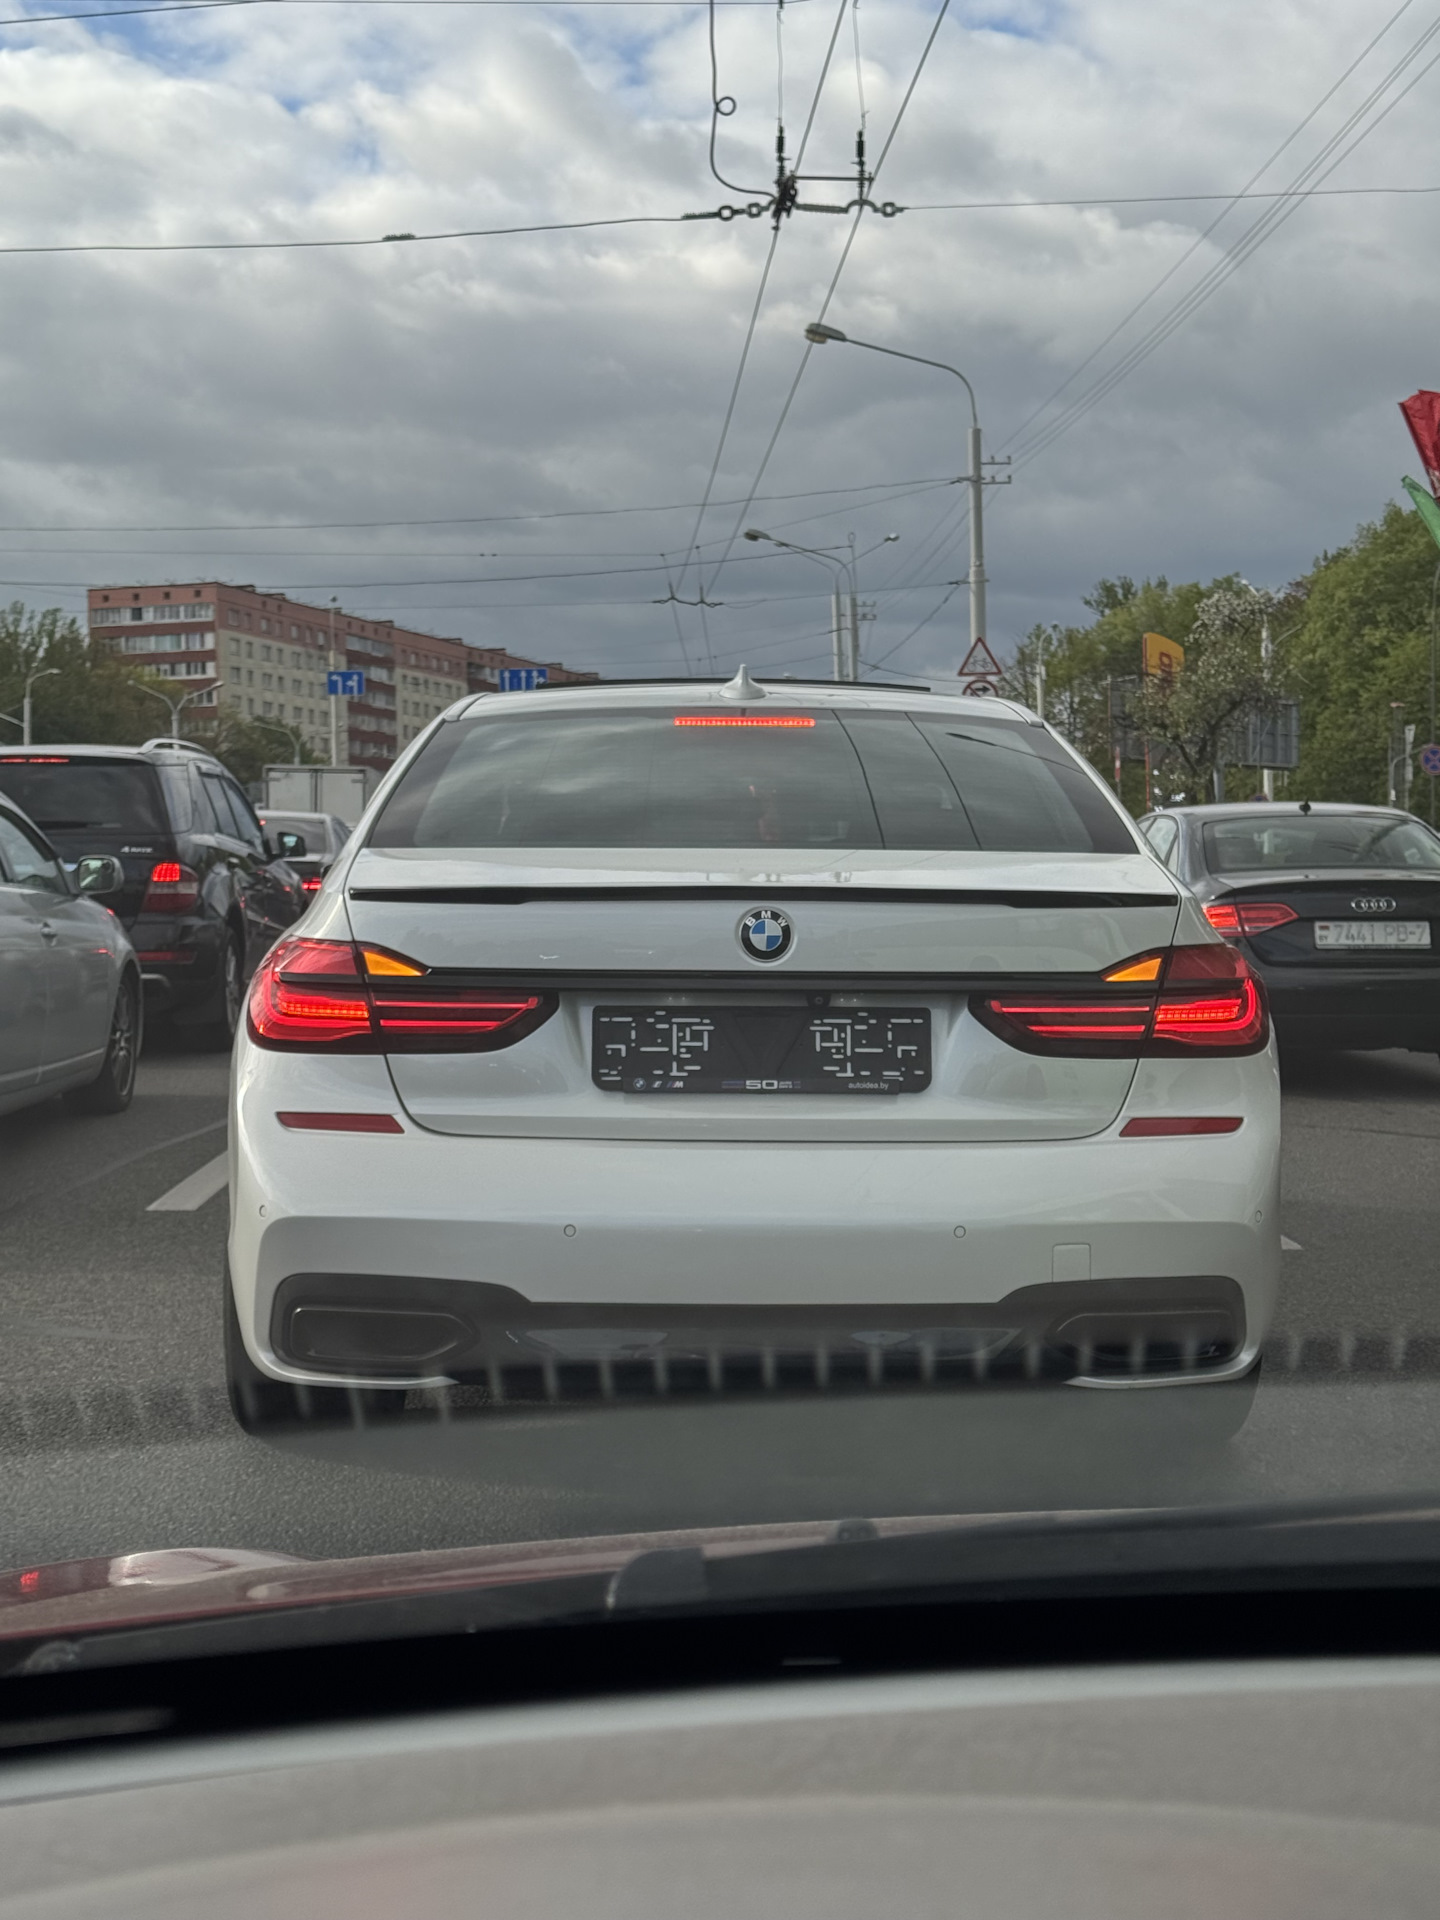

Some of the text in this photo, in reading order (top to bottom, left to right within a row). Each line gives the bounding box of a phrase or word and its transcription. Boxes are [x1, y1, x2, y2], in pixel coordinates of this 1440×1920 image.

[745, 910, 788, 927] BMW
[1333, 924, 1376, 943] 7441
[745, 1080, 778, 1090] 50
[848, 1081, 889, 1090] autoidea.by
